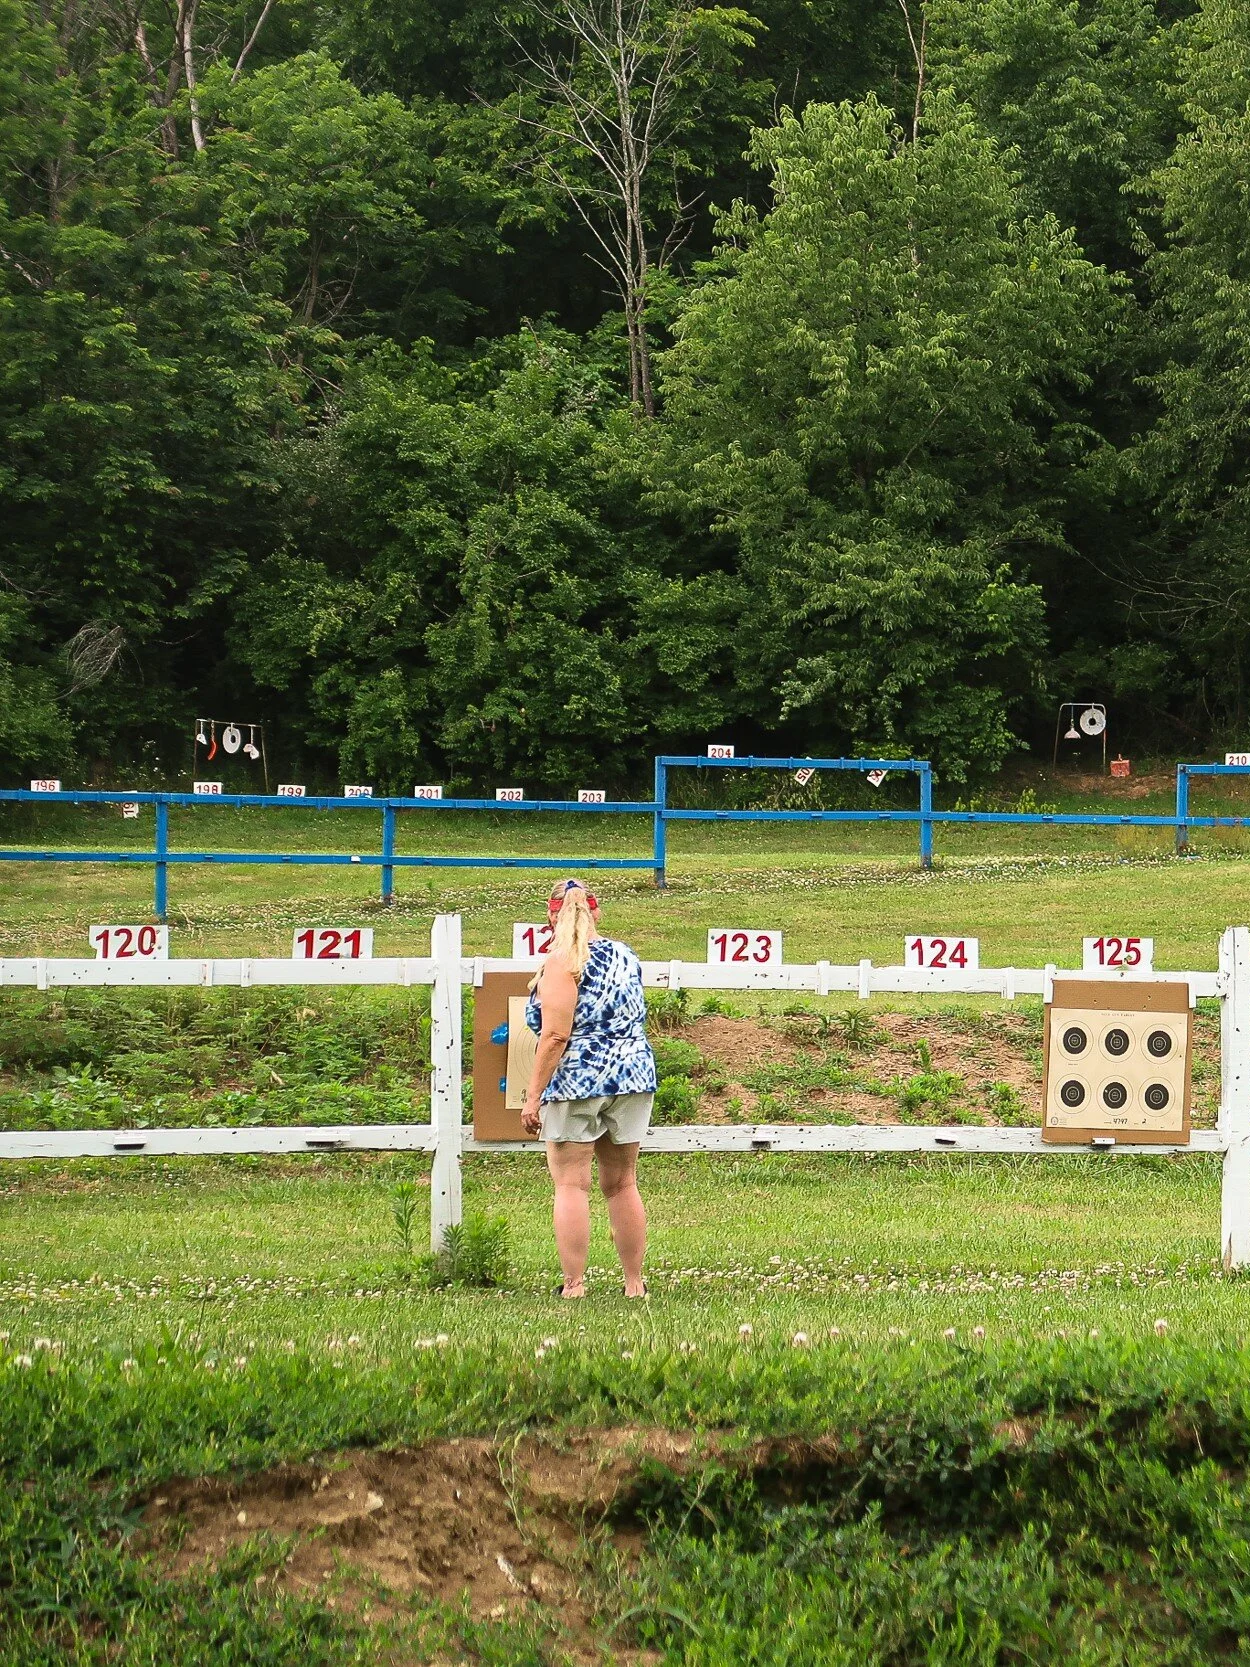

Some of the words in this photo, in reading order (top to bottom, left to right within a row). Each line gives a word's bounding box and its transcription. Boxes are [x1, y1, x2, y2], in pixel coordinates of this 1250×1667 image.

[710, 747, 732, 758] 204
[1228, 754, 1248, 766] 210
[797, 767, 810, 782] 05
[34, 780, 57, 792] 196
[195, 784, 219, 794] 198
[280, 786, 303, 796] 199
[418, 788, 439, 799] 201
[500, 791, 521, 801] 202
[581, 792, 603, 803] 203
[96, 925, 157, 959] 120
[297, 929, 361, 960] 121
[522, 926, 555, 956] 12
[714, 932, 772, 962] 123
[911, 937, 968, 968] 124
[1093, 937, 1141, 966] 125
